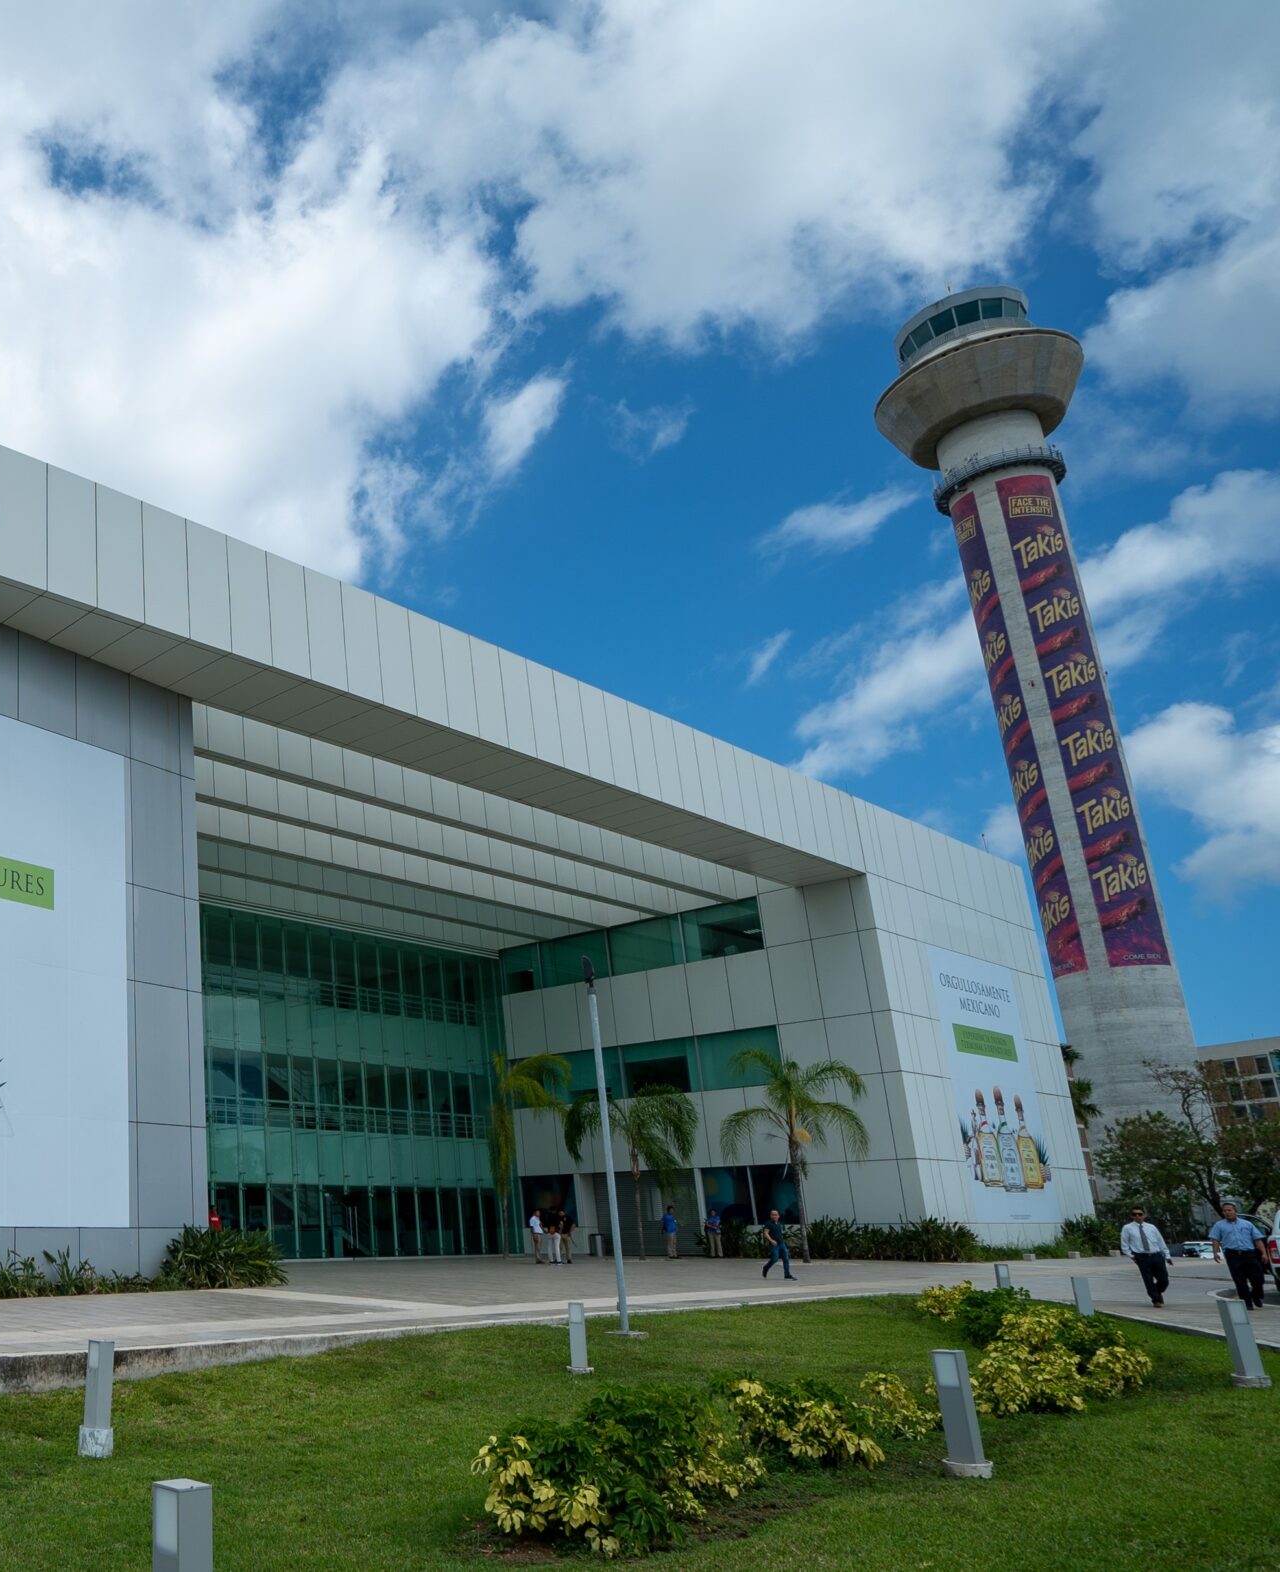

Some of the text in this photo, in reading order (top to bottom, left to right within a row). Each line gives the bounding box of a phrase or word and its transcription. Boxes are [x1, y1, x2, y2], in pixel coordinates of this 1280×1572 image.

[1011, 498, 1050, 506] FACE THE
[1013, 533, 1063, 569] Takis
[969, 570, 991, 608] kis
[1028, 597, 1080, 633] Takis
[982, 633, 1006, 671] akis
[1045, 661, 1096, 698] Takis
[997, 696, 1021, 736] akis
[1061, 729, 1114, 766] Takis
[1012, 762, 1038, 802] akis
[1076, 796, 1130, 835] Takis
[1026, 830, 1054, 870] akis
[1092, 863, 1146, 902] Takis
[1040, 896, 1069, 936] akis
[939, 972, 1011, 1003] ORGULLOSAMENTE
[959, 997, 1001, 1018] MEXICANO
